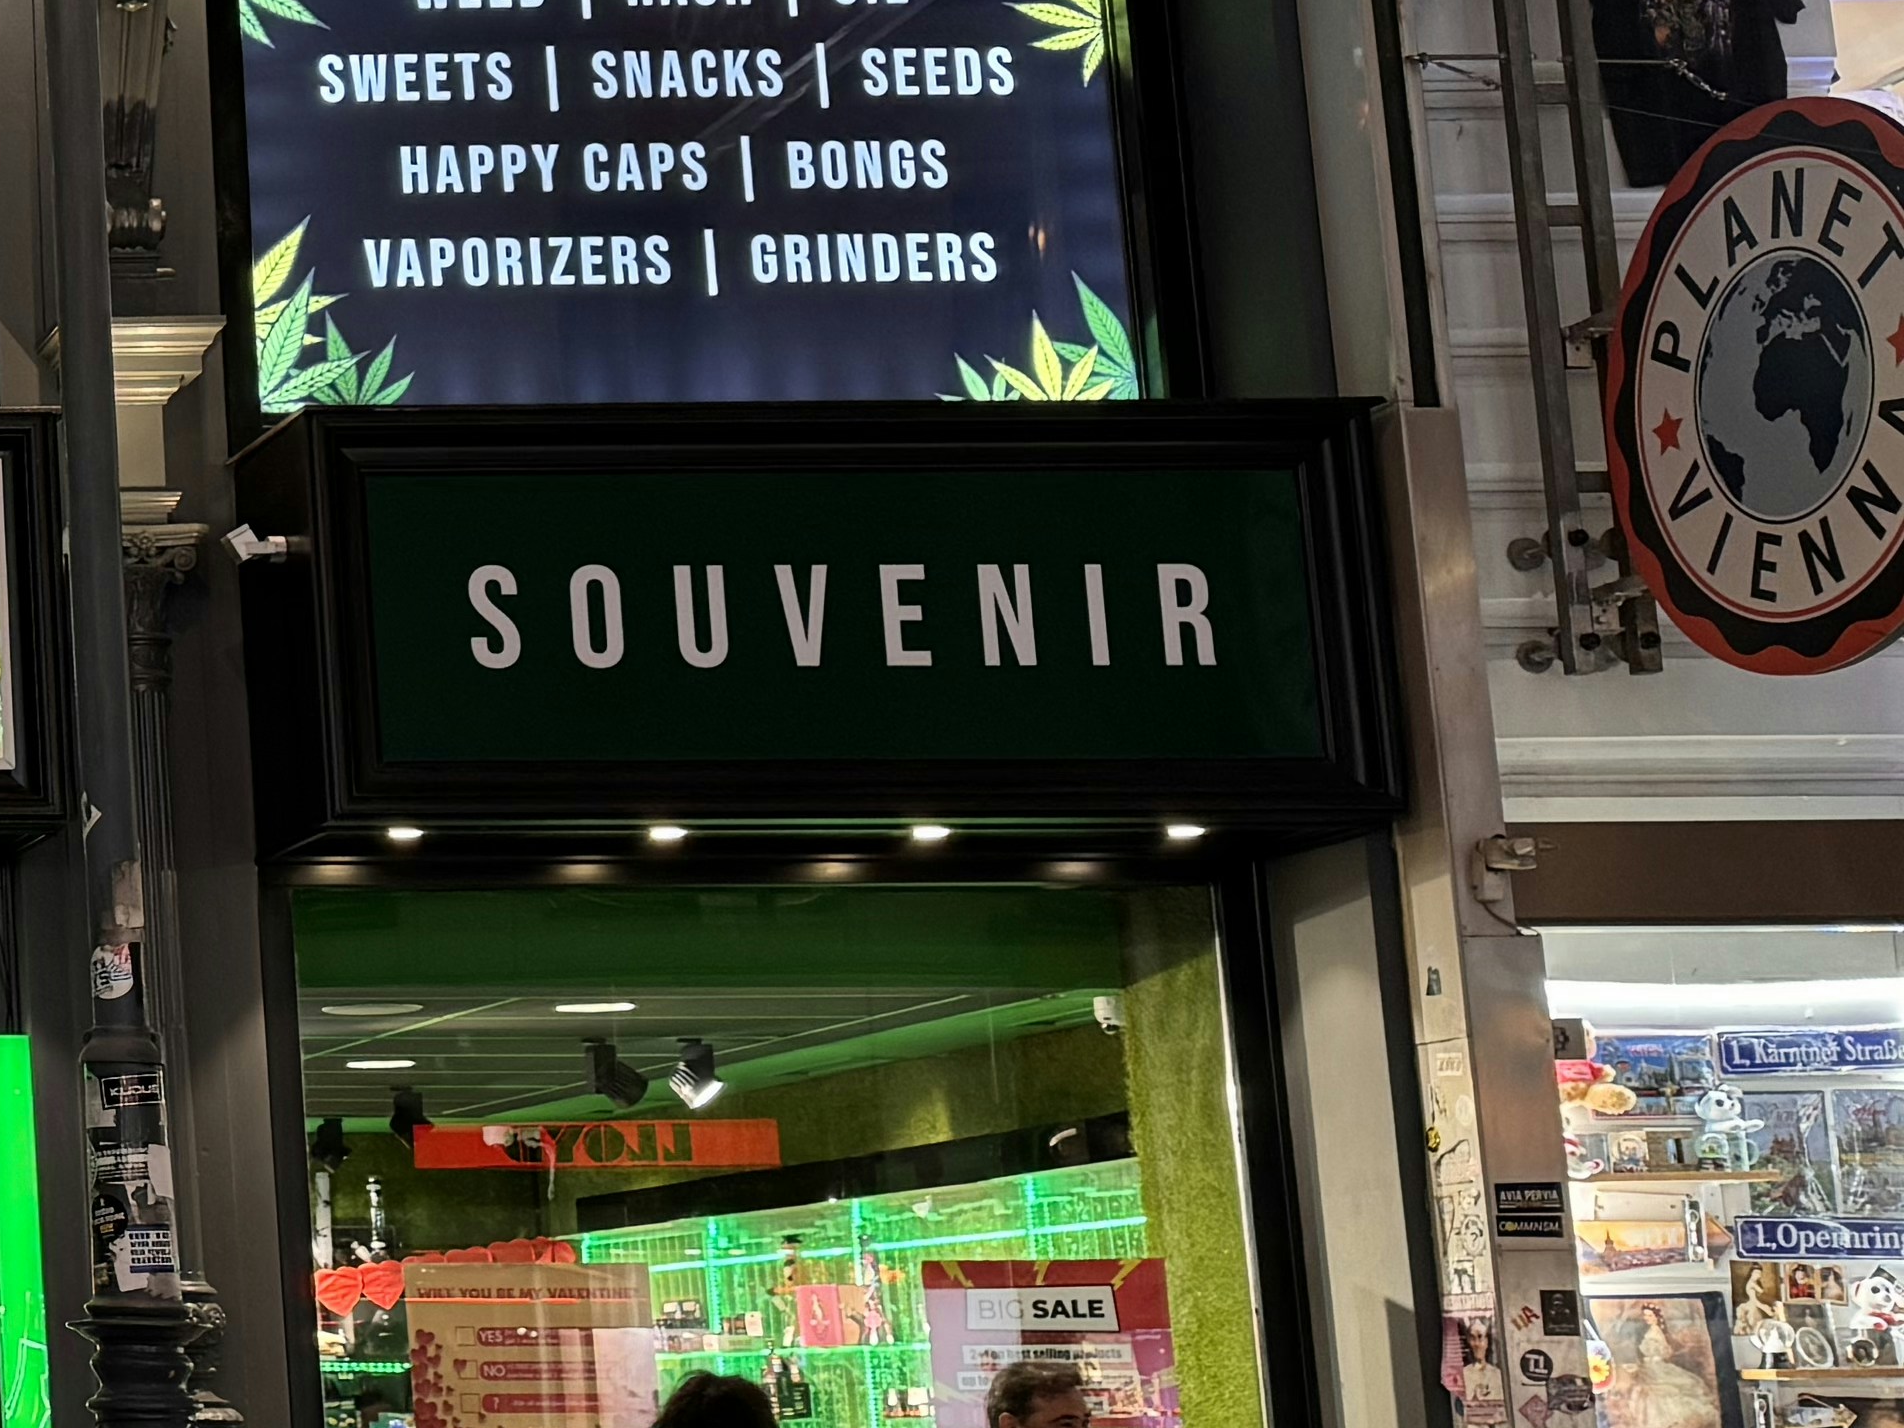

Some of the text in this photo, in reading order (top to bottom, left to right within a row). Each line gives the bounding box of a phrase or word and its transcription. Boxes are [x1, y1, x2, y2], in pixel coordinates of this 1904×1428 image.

[318, 46, 1015, 104] SWEETS SNACKS SEEDS
[400, 139, 949, 194] HAPPY CAPS BONGS
[364, 232, 997, 287] VAPORIZERS GRINDERS
[1651, 166, 1904, 373] PLANET
[466, 562, 1218, 670] SOUVENIR
[459, 1287, 493, 1299] YOU
[978, 1298, 1105, 1320] BIG SALE
[479, 1329, 503, 1343] YES
[482, 1366, 506, 1378] NO
